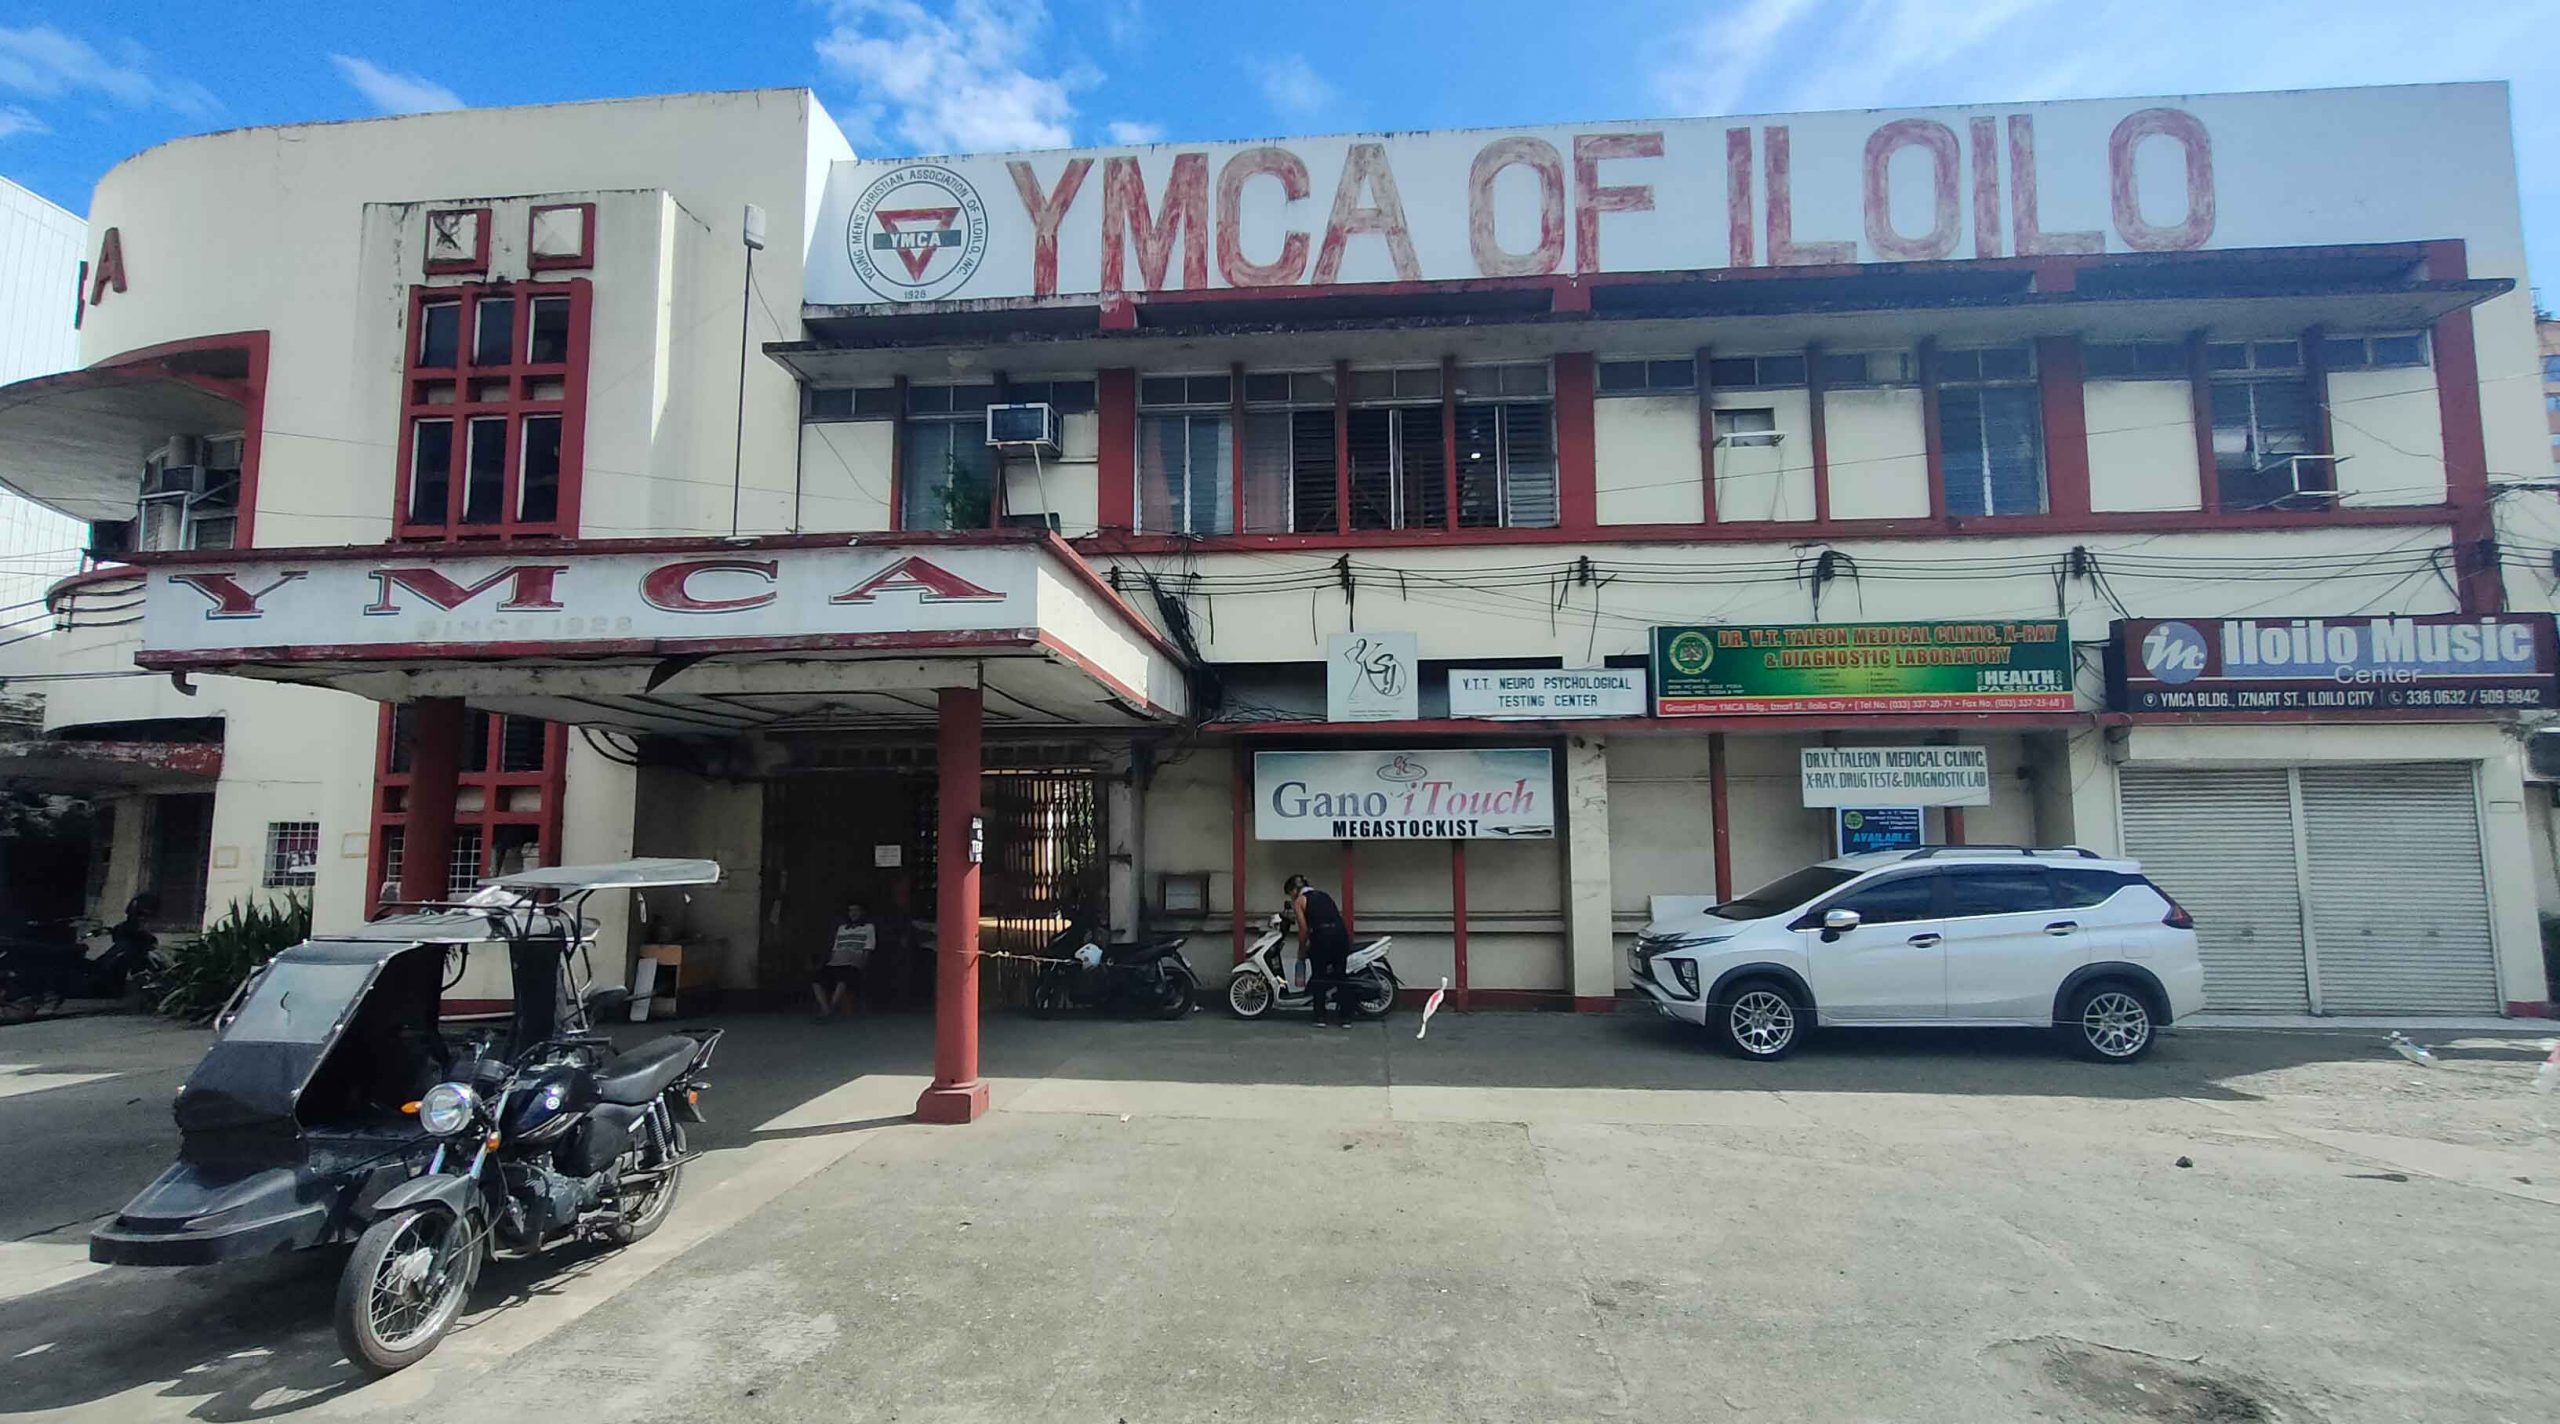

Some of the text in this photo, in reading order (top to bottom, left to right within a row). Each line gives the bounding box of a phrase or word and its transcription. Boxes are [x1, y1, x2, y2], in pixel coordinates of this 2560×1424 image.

[860, 172, 904, 213] CHRISTIAN
[908, 168, 969, 198] ASSOCIATION
[966, 198, 980, 215] OF
[1006, 107, 2216, 308] YMCA OF ILOILO
[890, 231, 942, 249] YMCA
[852, 249, 876, 283] YOUNG
[1717, 623, 2058, 648] DR. V.T. TALEON MEDICAL CLINIC, X-RAY
[2223, 614, 2534, 667] Iloilo Music
[1764, 646, 2012, 669] & DIAGNOSTIC LABORATORY
[1499, 676, 1535, 690] NEURO
[1544, 675, 1632, 690] PSYCHOLOGICAL
[1984, 669, 2055, 685] HEALTH
[2334, 665, 2420, 685] Center
[1977, 684, 2064, 693] PASSION
[2160, 692, 2195, 708] YMCA
[2197, 691, 2236, 708] BLDG.,
[2237, 690, 2281, 707] IZNART
[2307, 690, 2344, 706] ILOILO
[2347, 690, 2375, 706] CITY
[2433, 689, 2466, 704] 0632
[2479, 688, 2504, 704] 509
[2506, 688, 2540, 704] 9842
[1498, 694, 1598, 708] TESTING CENTER
[1886, 750, 1943, 768] MEDICAL
[1839, 771, 1868, 789] DRUG
[1868, 771, 1891, 788] TEST
[1891, 771, 1903, 788] &
[1903, 770, 1966, 788] DIAGNOSTIC
[1272, 781, 1388, 819] Gano
[1332, 819, 1480, 838] MEGASTOCKIST
[1852, 832, 1912, 843] AVAILABLE
